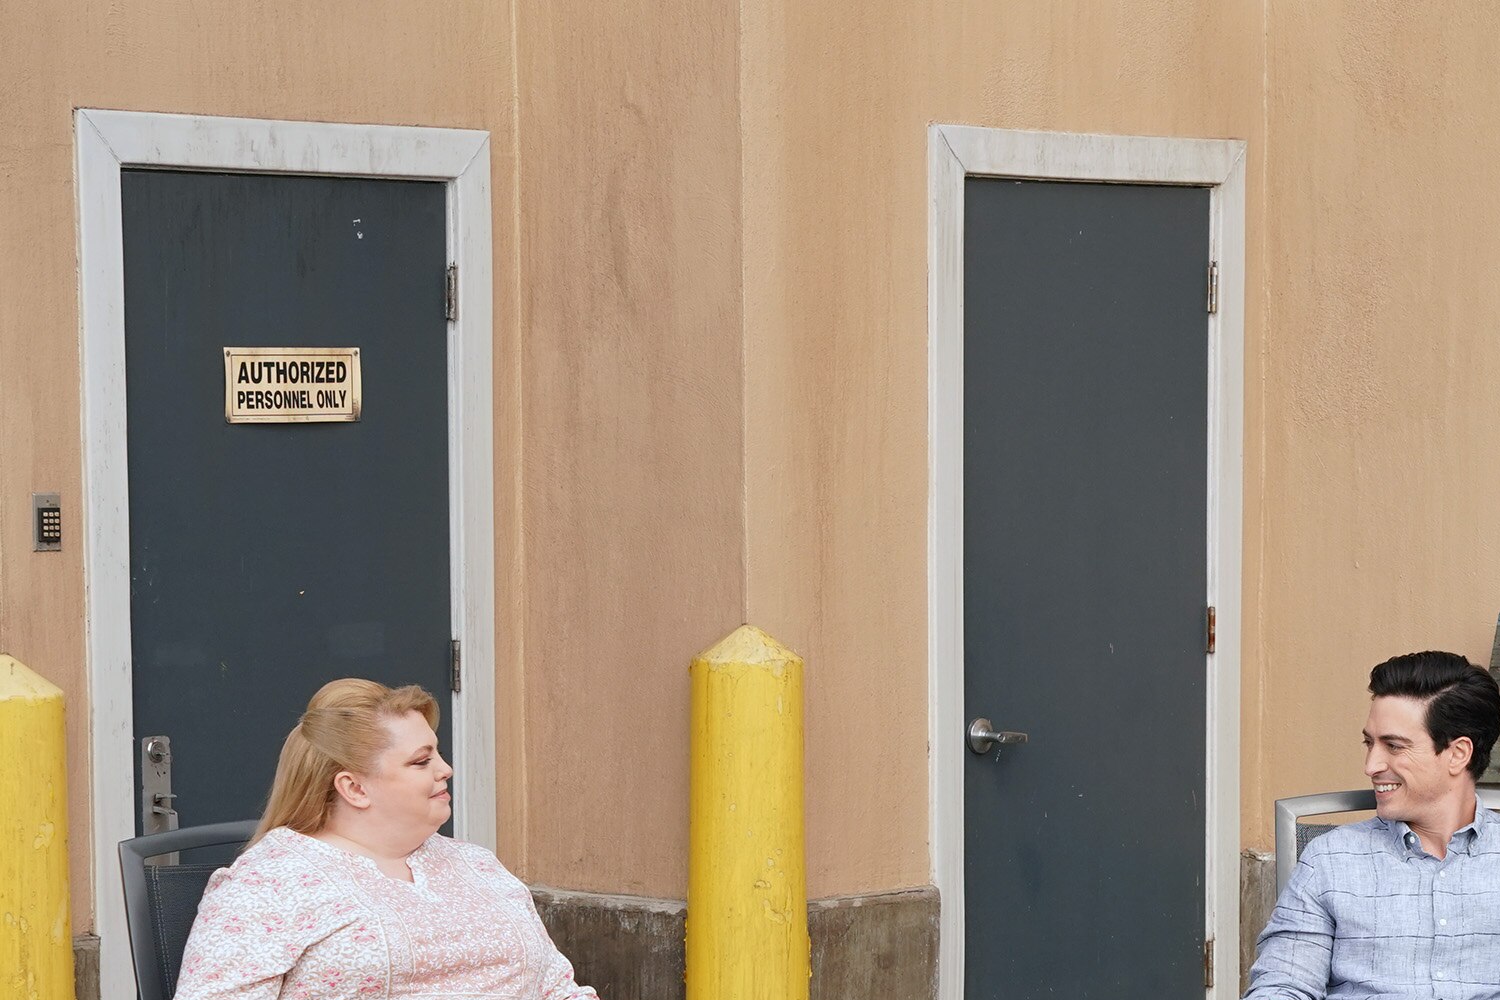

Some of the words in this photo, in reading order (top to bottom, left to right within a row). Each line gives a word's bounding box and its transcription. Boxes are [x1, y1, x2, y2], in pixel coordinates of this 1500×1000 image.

[237, 361, 347, 384] AUTHORIZED
[237, 390, 313, 409] PERSONNEL
[316, 389, 347, 409] ONLY
